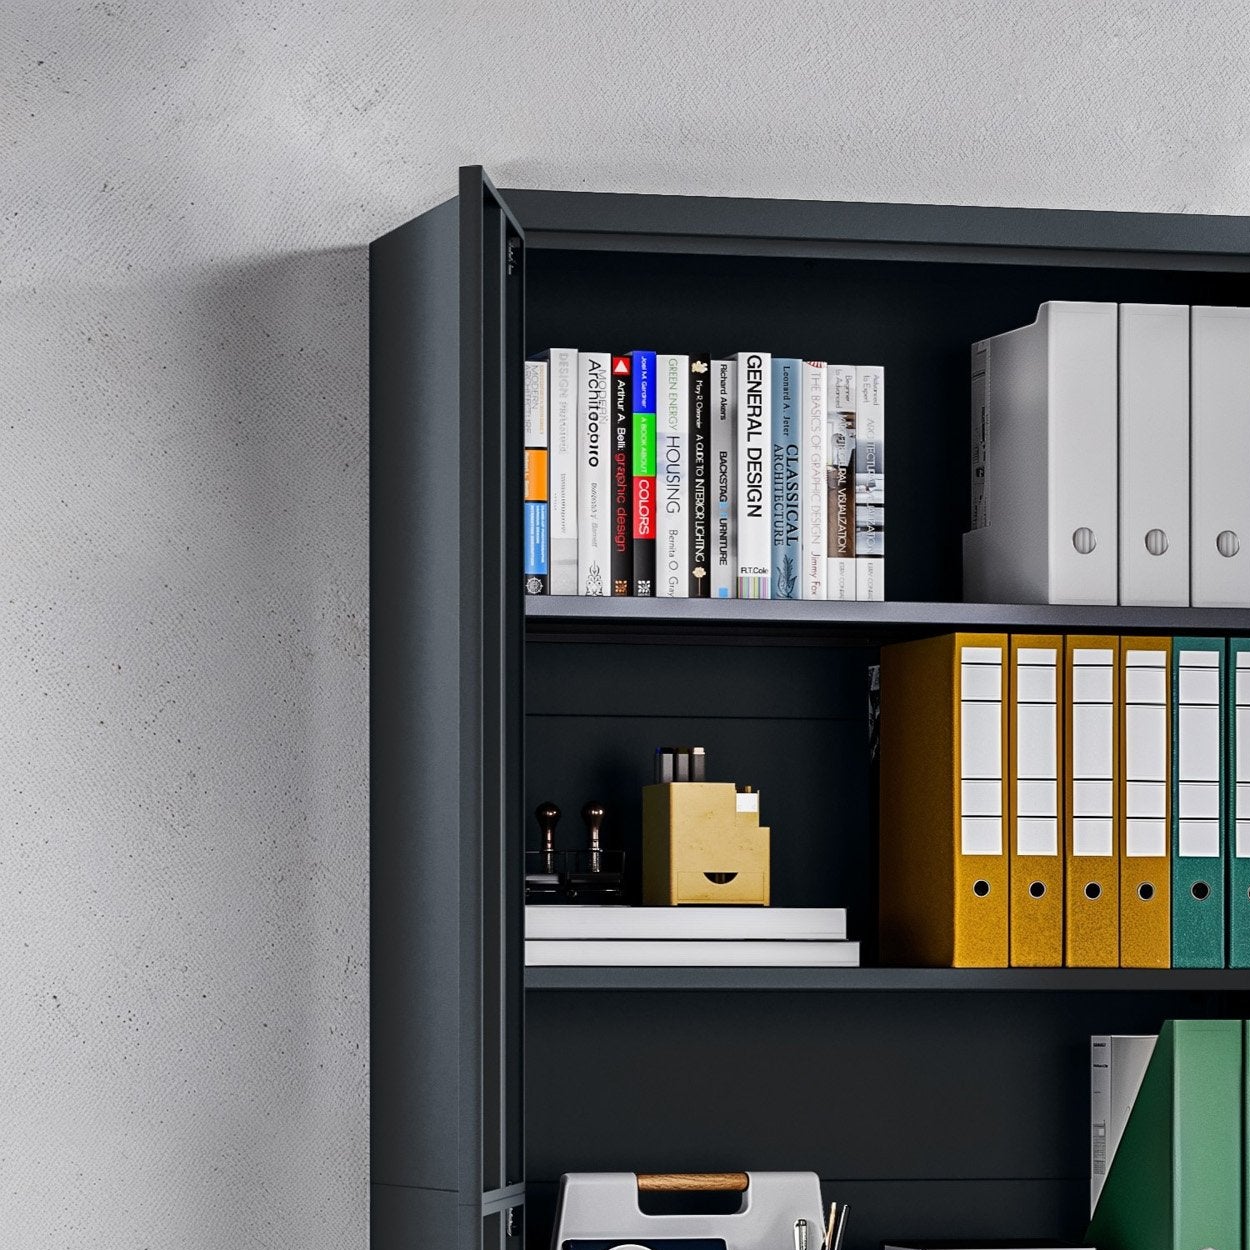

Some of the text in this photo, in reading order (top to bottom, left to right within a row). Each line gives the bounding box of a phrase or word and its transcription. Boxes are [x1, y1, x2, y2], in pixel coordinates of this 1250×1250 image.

[617, 379, 626, 411] Arthur
[668, 358, 678, 431] GREEN ENERGY
[694, 379, 703, 394] Mary
[720, 363, 728, 421] Richard Akers
[783, 365, 791, 436] Leonard A. Jeter
[862, 383, 871, 403] Expert
[873, 374, 881, 406] Advanced
[617, 412, 626, 424] A.
[747, 354, 762, 518] GENERAL DESIGN
[614, 453, 627, 504] graphic
[665, 436, 681, 514] HOUSING
[696, 464, 704, 477] TO
[810, 371, 822, 544] THE BASICS OF GRAPHIC DESIGN
[638, 479, 650, 535] COLORS
[695, 478, 705, 563] INTERIOR LIGHTING
[774, 443, 784, 547] ARCHITECTURE
[786, 444, 799, 547] CLASSICAL
[837, 487, 848, 553] VISUALIZATION
[615, 507, 627, 552] design
[668, 529, 679, 558] Bernita
[667, 576, 679, 597] Gray
[809, 551, 821, 595] Jimmy Fox
